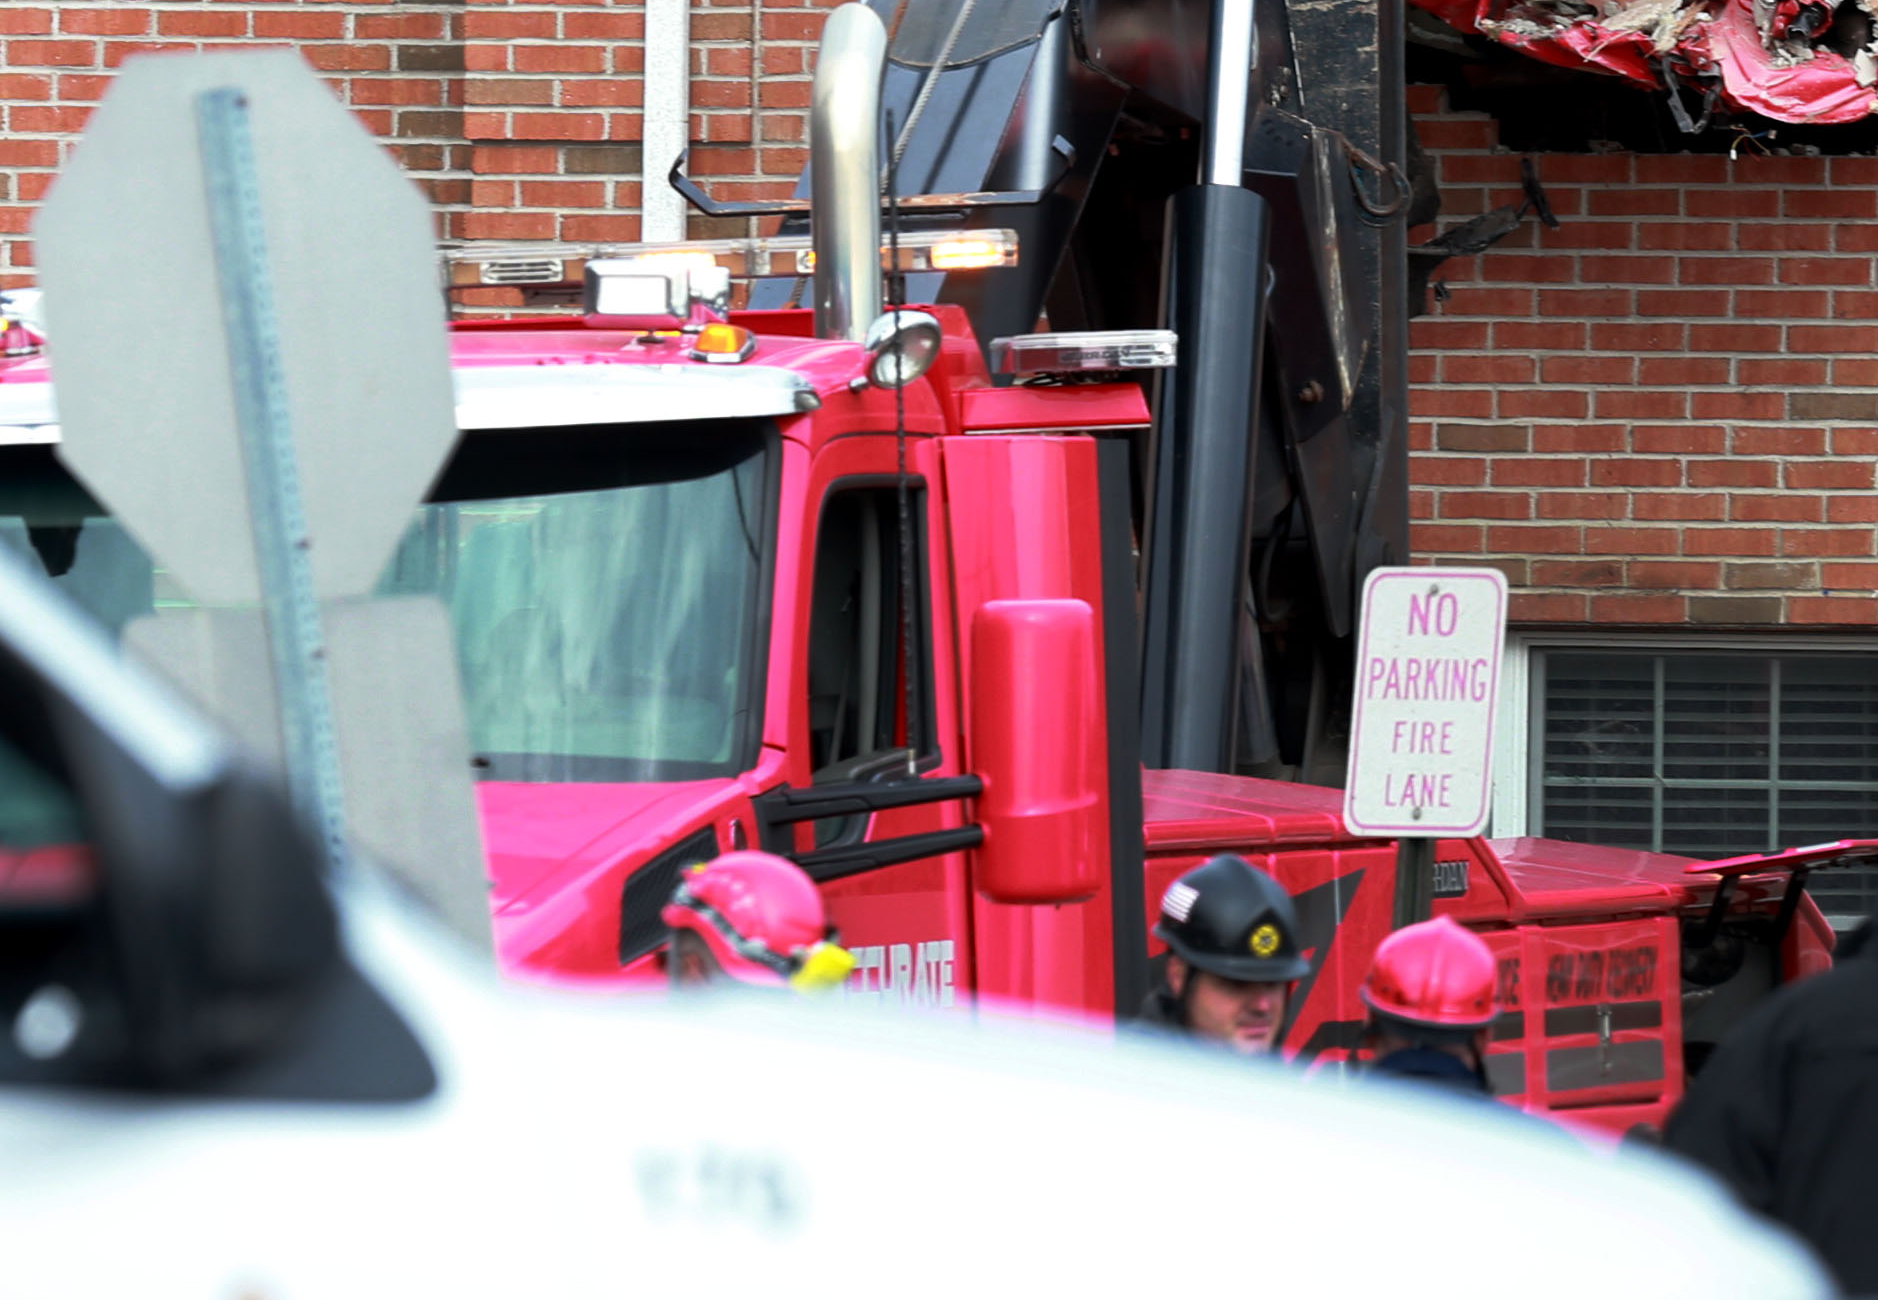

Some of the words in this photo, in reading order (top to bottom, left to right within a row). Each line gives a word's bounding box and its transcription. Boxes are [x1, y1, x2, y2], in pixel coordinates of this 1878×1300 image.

[1407, 592, 1458, 636] NO
[1367, 657, 1488, 702] PARKING
[1392, 720, 1454, 754] FIRE
[1384, 773, 1453, 808] LANE
